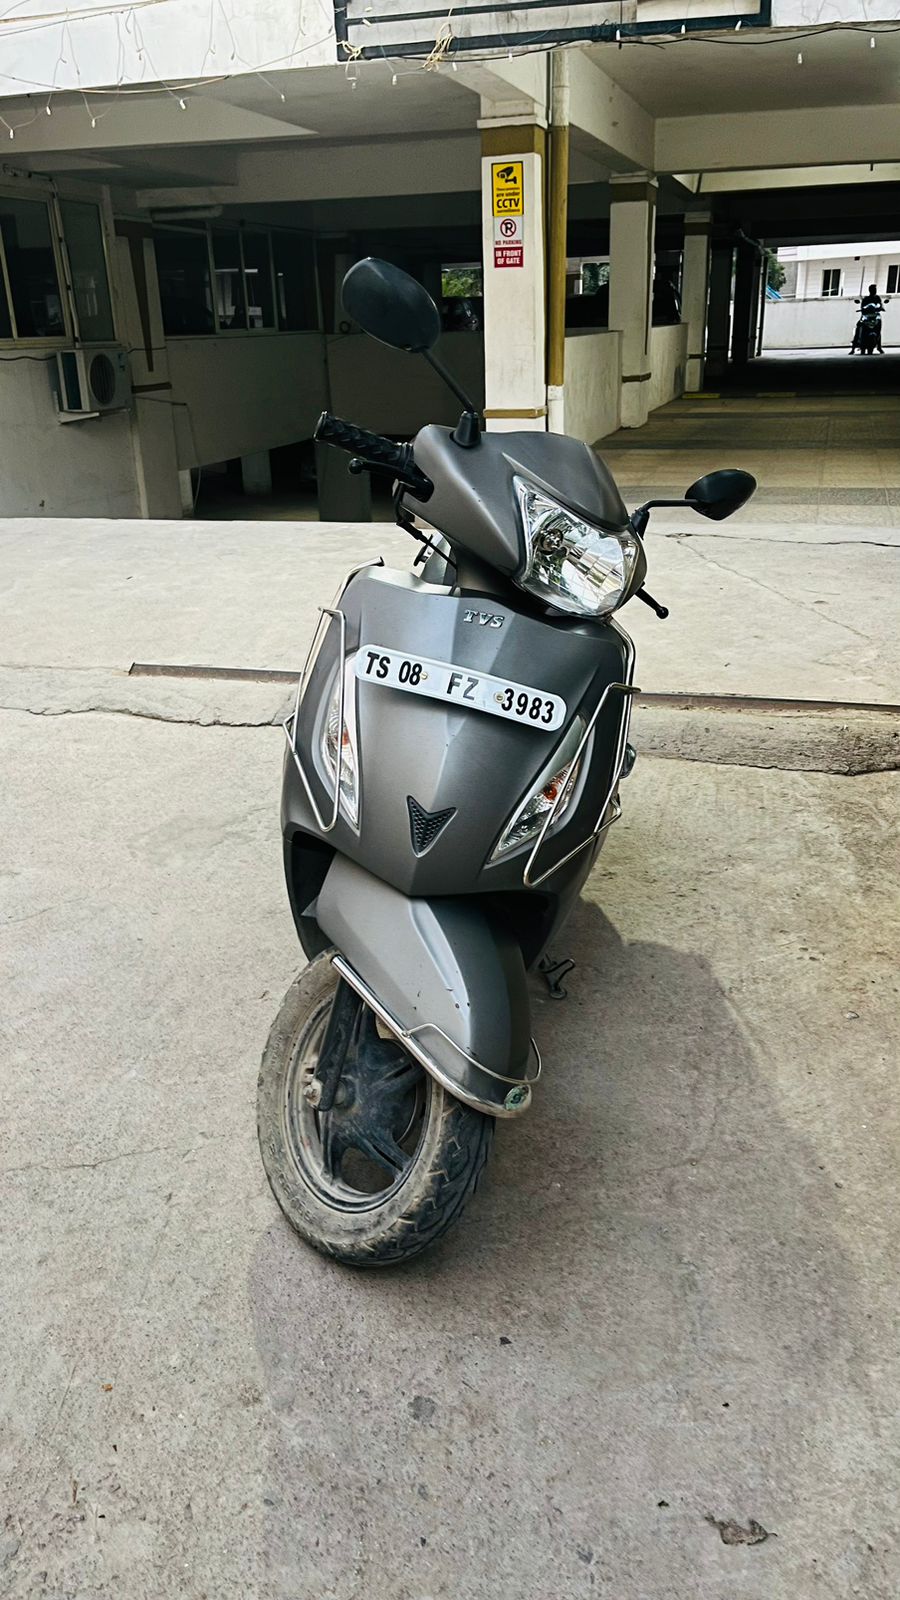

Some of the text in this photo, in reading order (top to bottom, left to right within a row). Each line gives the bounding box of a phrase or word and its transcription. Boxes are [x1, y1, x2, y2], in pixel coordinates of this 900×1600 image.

[496, 198, 520, 208] CCTV
[505, 257, 521, 265] GATE
[463, 609, 505, 629] TVS
[365, 651, 555, 724] TS 08 FZ 3983
